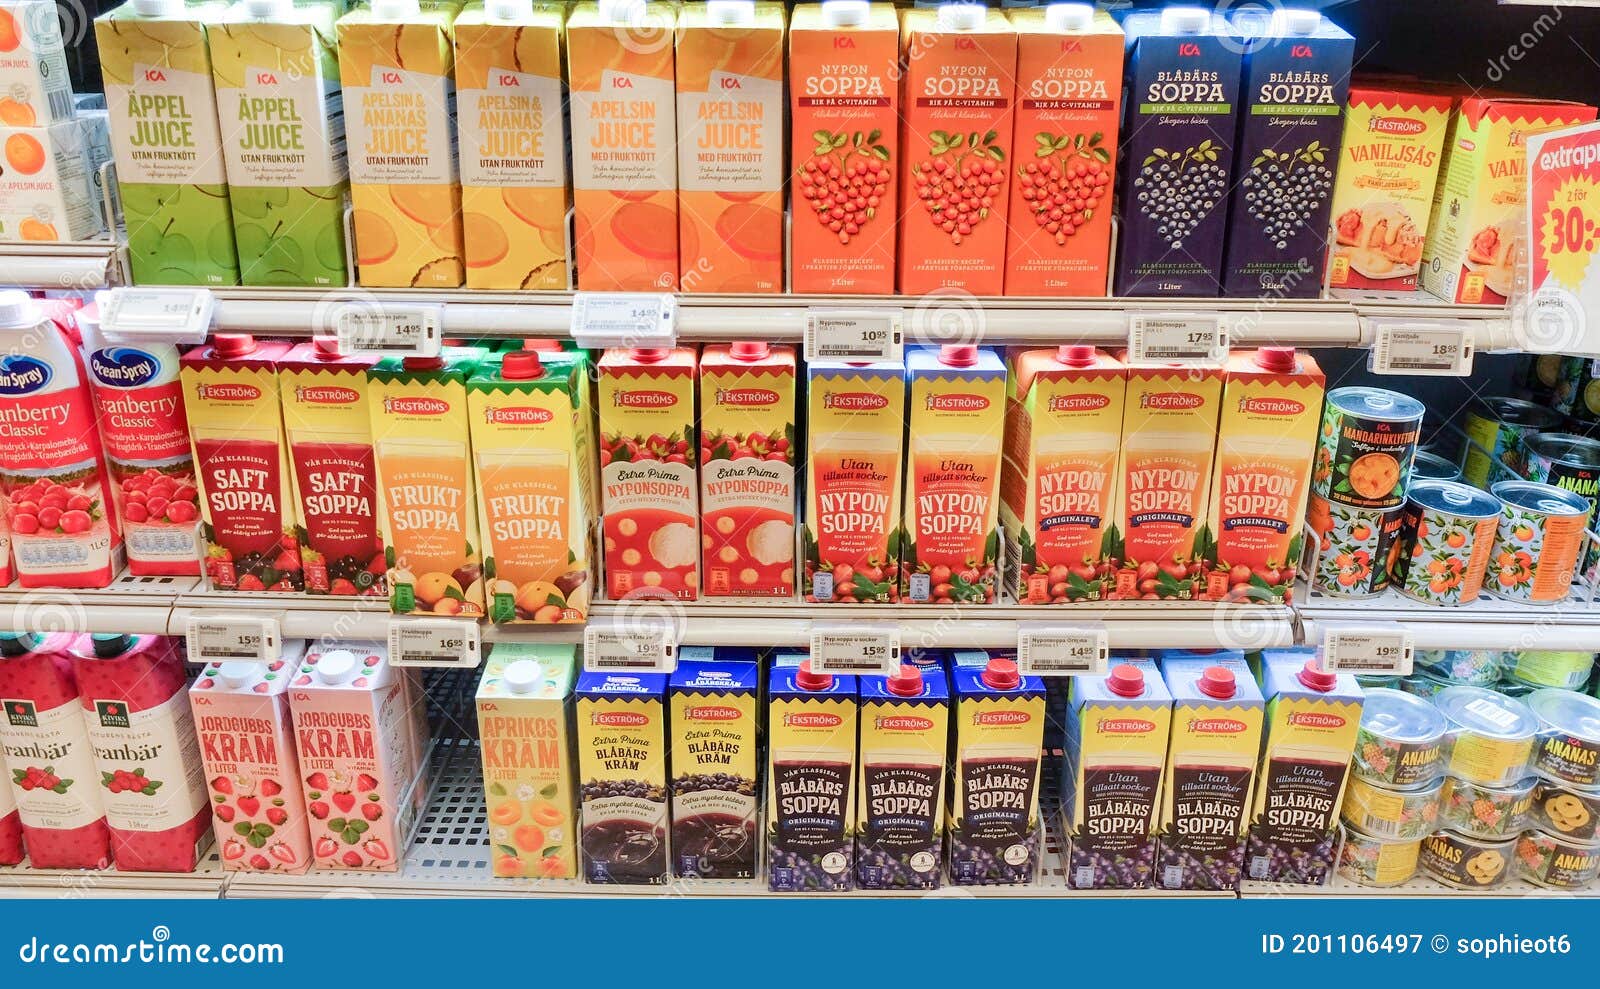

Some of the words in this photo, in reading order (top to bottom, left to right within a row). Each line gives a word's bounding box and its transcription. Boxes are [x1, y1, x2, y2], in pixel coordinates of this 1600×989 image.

[145, 71, 166, 82] ICA
[822, 65, 868, 75] NYPON
[941, 66, 987, 76] NYPON
[1158, 70, 1217, 81] BLÅBÄRS
[500, 76, 519, 86] ICA
[721, 79, 740, 89] ICA
[806, 77, 883, 97] SOPPA
[1031, 80, 1108, 100] SOPPA
[1148, 84, 1224, 102] SOPPA
[128, 91, 191, 118] ÄPPEL
[239, 94, 301, 121] ÄPPEL
[363, 93, 414, 107] APELSIN
[416, 94, 425, 107] &
[478, 96, 529, 110] APELSIN
[532, 96, 542, 110] &
[364, 110, 426, 126] ANANAS
[590, 102, 655, 119] APELSIN
[698, 102, 763, 120] APELSIN
[479, 112, 542, 129] ANANAS
[1378, 120, 1422, 131] EKSTRÖMS
[130, 121, 194, 147] JUICE
[240, 124, 304, 150] JUICE
[366, 129, 428, 154] JUICE
[591, 123, 656, 148] JUICE
[698, 124, 763, 148] JUICE
[132, 151, 151, 160] UTAN
[153, 151, 196, 161] FRUKTKÖTT
[592, 152, 608, 161] MED
[610, 152, 655, 161] FRUKTKÖTT
[1349, 144, 1435, 167] VANILJSÅS
[480, 160, 499, 168] UTAN
[501, 160, 544, 168] FRUKTKÖTT
[307, 390, 355, 400] EKSTRÖMS
[624, 395, 673, 404] EKSTRÖMS
[725, 393, 774, 402] EKSTRÖMS
[1150, 396, 1198, 406] EKSTRÖMS
[394, 402, 445, 412] EKSTRÖMS
[936, 399, 984, 408] EKSTRÖMS
[1249, 400, 1300, 412] EKSTRÖMS
[111, 415, 153, 428] Classic
[1377, 423, 1390, 431] ICA
[226, 456, 269, 465] KLASSISKA
[841, 459, 873, 470] Utan
[214, 468, 268, 490] SAFT
[309, 472, 364, 493] SAFT
[617, 470, 645, 481] Extra
[648, 469, 680, 481] Prima
[823, 471, 854, 481] tillsatt
[855, 471, 888, 481] socker
[1130, 469, 1200, 492] NYPON
[608, 483, 690, 499] NYPONSOPPA
[707, 480, 789, 496] NYPONSOPPA
[1226, 474, 1298, 497] NYPON
[211, 492, 276, 513] SOPPA
[390, 485, 461, 508] FRUKT
[821, 493, 889, 513] NYPON
[920, 494, 988, 515] NYPON
[1130, 491, 1192, 512] SOPPA
[489, 495, 564, 517] FRUKT
[393, 509, 460, 532] SOPPA
[822, 514, 884, 534] SOPPA
[921, 515, 982, 535] SOPPA
[1046, 516, 1095, 524] ORIGINALET
[1230, 518, 1282, 528] ORIGINALET
[195, 697, 212, 705] ICA
[298, 712, 370, 729] JORDGUBBS
[693, 710, 737, 718] EKSTRÖMS
[1296, 715, 1341, 726] EKSTRÖMS
[200, 716, 272, 734] JORDGUBBS
[484, 717, 557, 739] APRIKOS
[1106, 722, 1151, 730] EKSTRÖMS
[685, 730, 709, 740] Extra
[712, 729, 742, 740] Prima
[202, 732, 277, 765] KRÄM
[300, 729, 374, 759] KRÄM
[688, 740, 739, 755] BLÅBÄRS
[1545, 737, 1596, 765] ANANAS
[485, 739, 560, 769] KRÄM
[596, 746, 647, 760] BLÅBÄRS
[697, 753, 730, 764] KRÄM
[215, 764, 237, 774] LITER
[605, 760, 639, 770] KRÄM
[988, 764, 1026, 773] KLASSISKA
[1294, 766, 1323, 777] Utan
[968, 774, 1029, 791] BLÅBÄRS
[1109, 773, 1138, 783] Utan
[1276, 775, 1305, 784] tillsatt
[1306, 777, 1335, 787] socker
[781, 778, 843, 795] BLÅBÄRS
[1092, 783, 1120, 792] tillsatt
[1121, 784, 1150, 792] socker
[782, 796, 840, 815] SOPPA
[968, 792, 1025, 810] SOPPA
[1270, 792, 1332, 812] BLÅBÄRS
[1178, 801, 1240, 818] BLÅBÄRS
[1089, 818, 1144, 835] SOPPA
[1269, 810, 1324, 829] SOPPA
